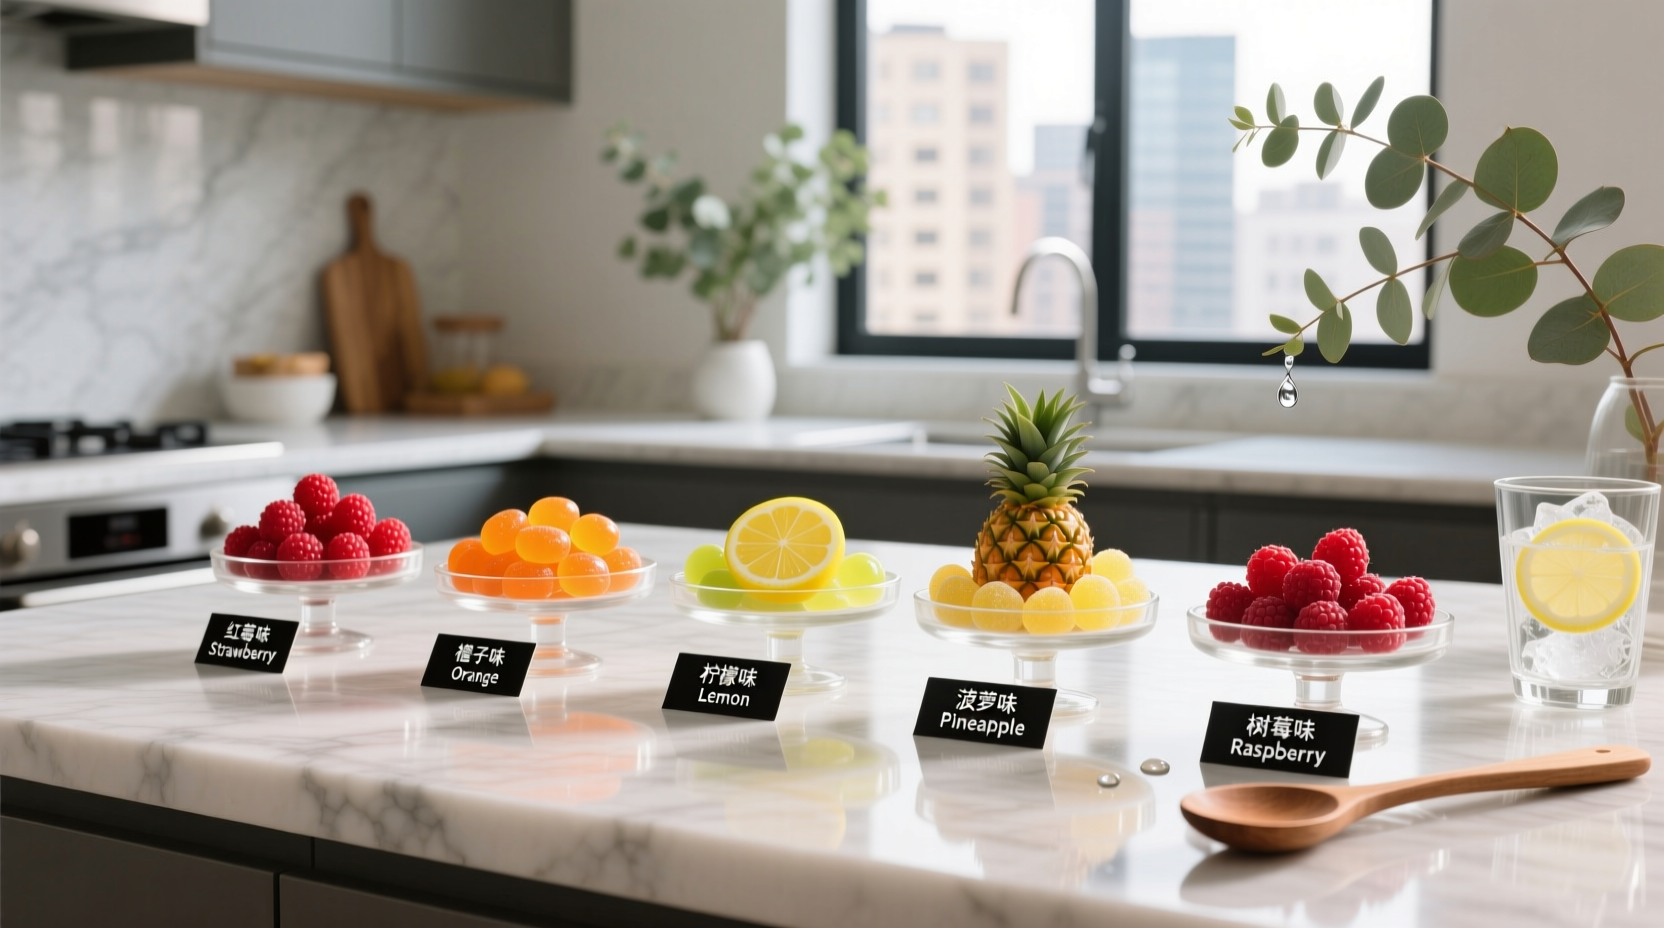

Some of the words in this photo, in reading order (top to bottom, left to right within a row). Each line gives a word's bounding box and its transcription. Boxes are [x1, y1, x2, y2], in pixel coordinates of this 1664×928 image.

[208, 641, 277, 665] Strawberry
[451, 666, 499, 688] Orange
[699, 662, 758, 688] 柠檬味
[697, 687, 750, 707] Lemon
[955, 688, 1018, 715] 菠萝味
[939, 711, 1025, 739] Pineapple
[1246, 712, 1316, 742] 树莓味
[1230, 737, 1327, 768] Raspberry
